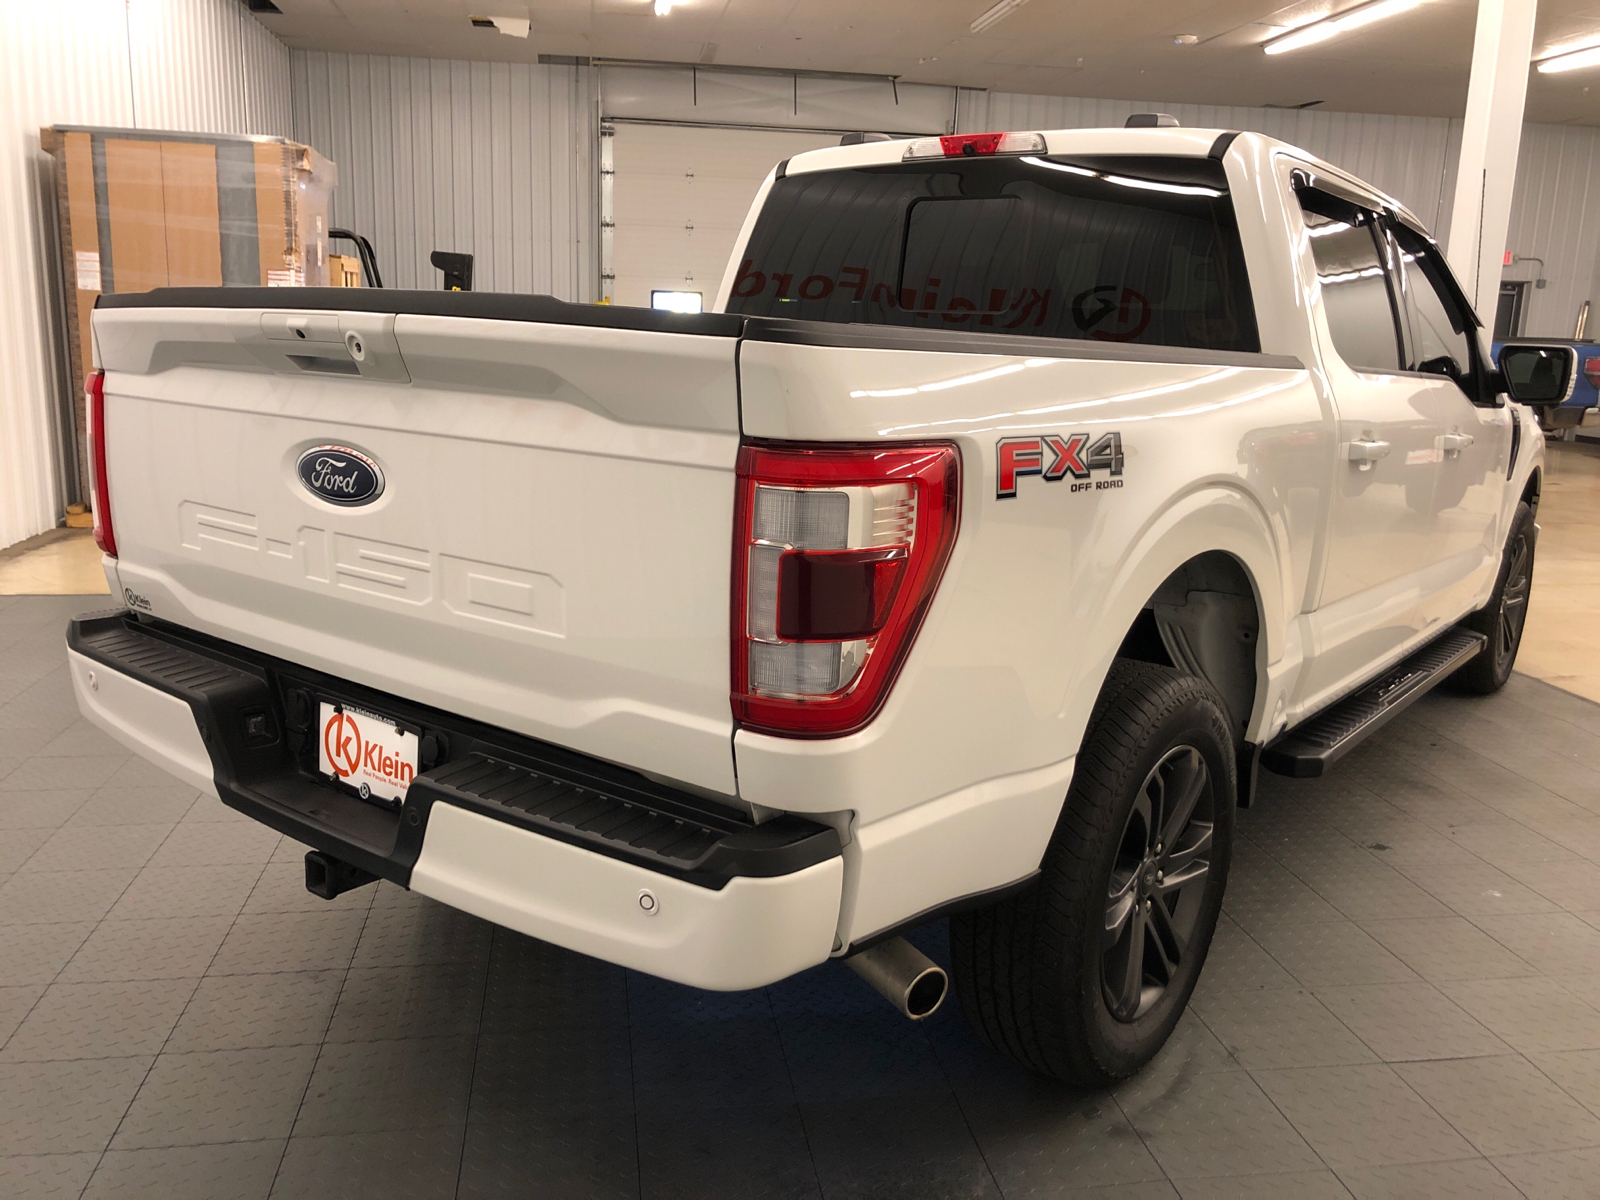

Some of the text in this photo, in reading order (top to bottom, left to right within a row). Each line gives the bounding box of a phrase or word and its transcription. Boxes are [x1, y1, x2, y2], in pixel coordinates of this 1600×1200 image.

[311, 457, 359, 494] Ford
[996, 432, 1124, 499] FX4
[1070, 479, 1124, 492] OFF ROAD
[178, 500, 567, 639] F-150
[363, 740, 414, 784] Klein
